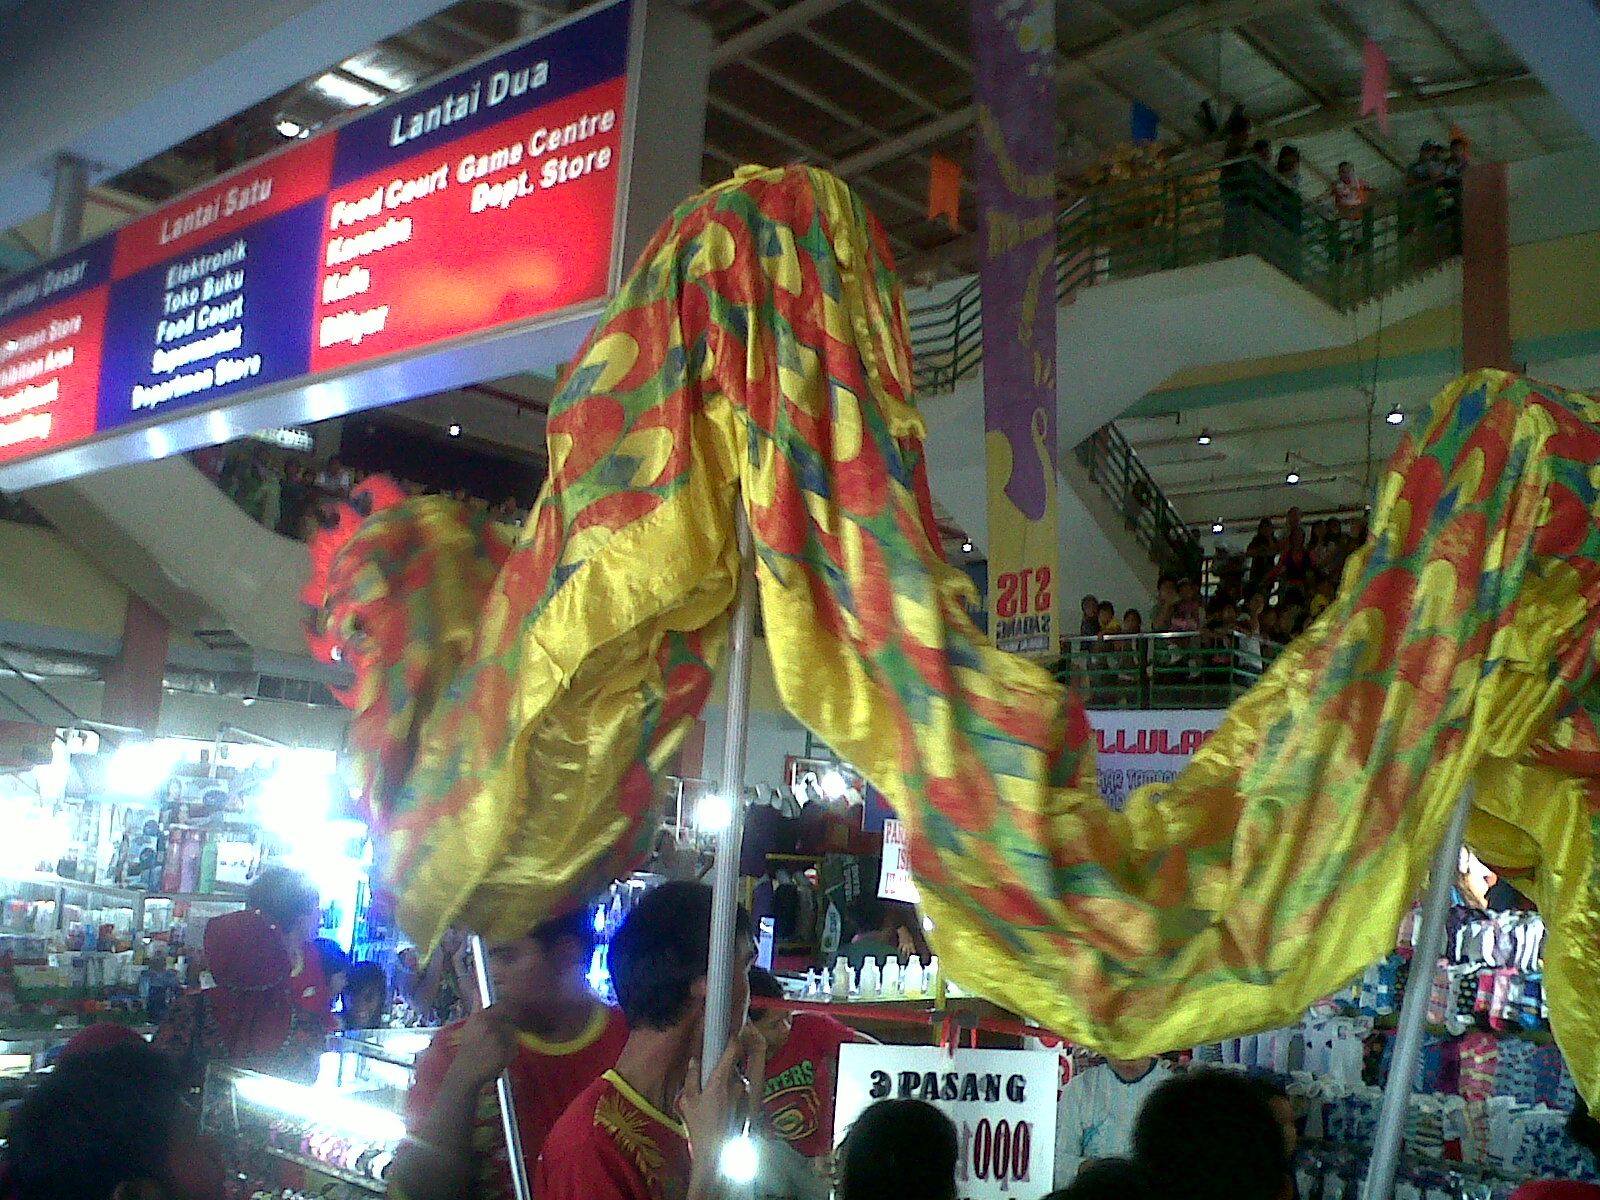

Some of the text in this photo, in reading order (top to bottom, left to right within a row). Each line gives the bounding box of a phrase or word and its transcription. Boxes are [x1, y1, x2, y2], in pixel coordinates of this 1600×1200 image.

[389, 59, 549, 147] Lantai Dua
[457, 109, 616, 184] Game Centre
[540, 146, 612, 189] Store
[160, 178, 272, 245] Lantai Satu
[385, 163, 449, 209] Court
[869, 1070, 1027, 1103] 3 PASANG
